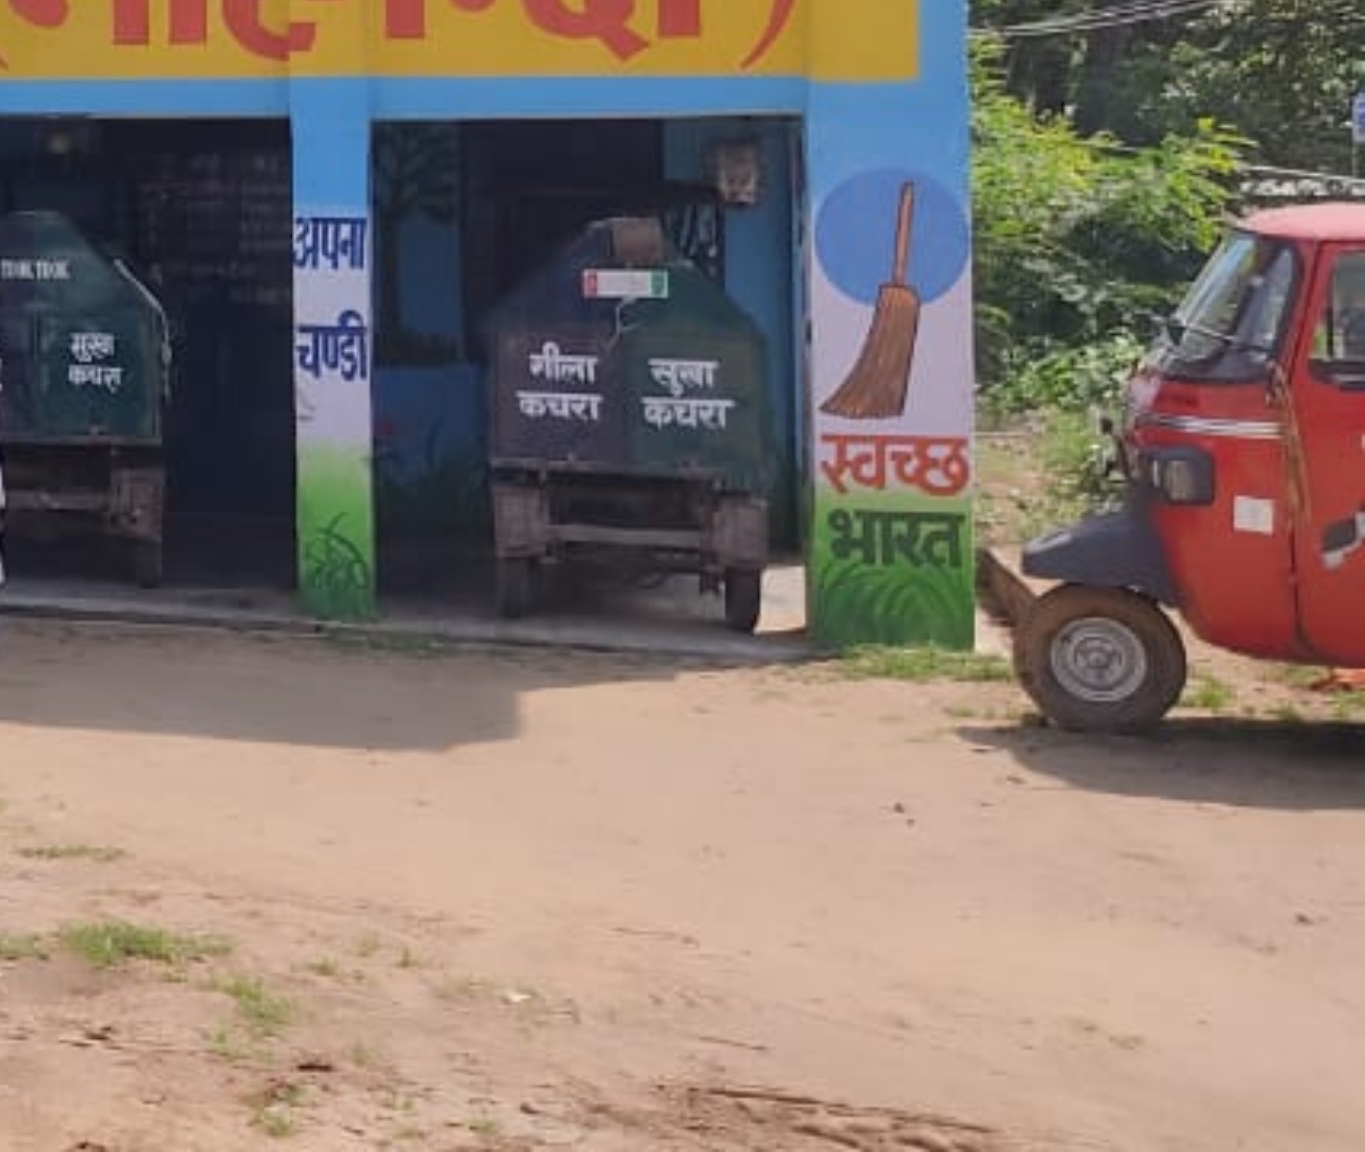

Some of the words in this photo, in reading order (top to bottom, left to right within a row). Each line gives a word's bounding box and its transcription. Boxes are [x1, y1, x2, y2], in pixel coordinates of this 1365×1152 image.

[293, 218, 367, 269] अपना
[296, 310, 367, 381] चण्डी
[529, 342, 599, 383] गीला
[516, 389, 604, 419] कचरा
[641, 397, 735, 428] कचरा
[820, 435, 969, 496] स्वच्छ
[827, 509, 965, 567] भारत
